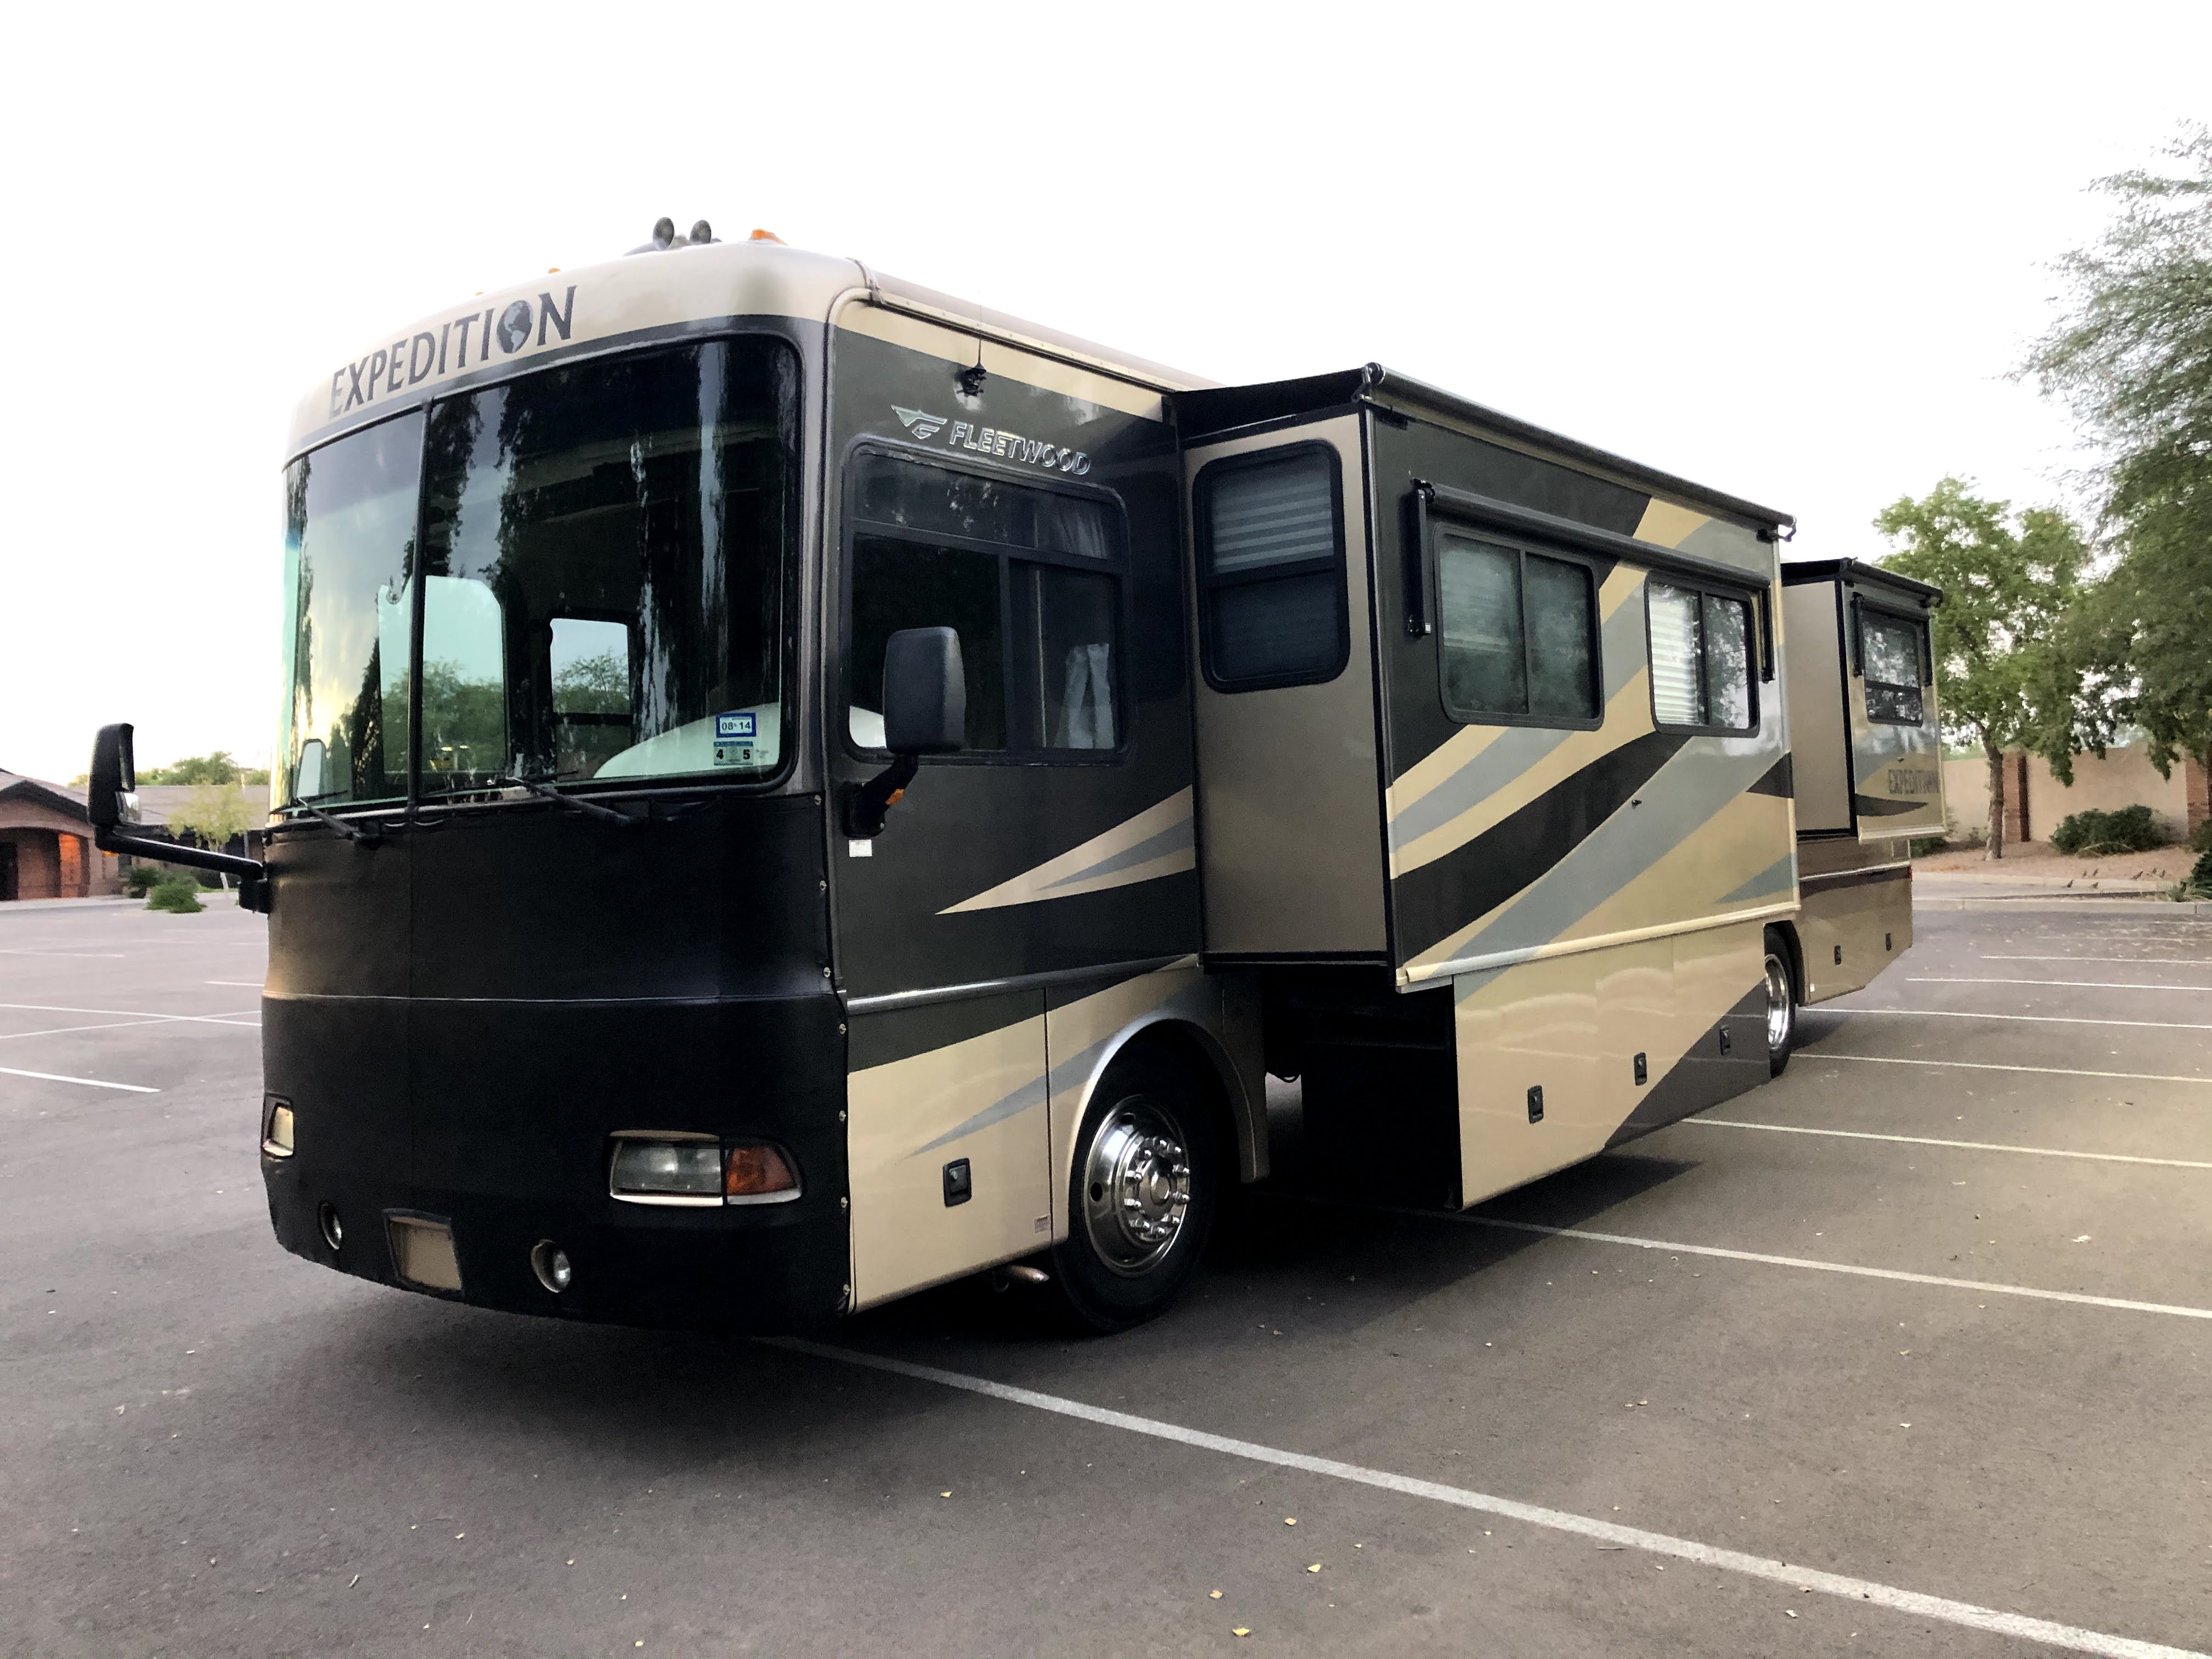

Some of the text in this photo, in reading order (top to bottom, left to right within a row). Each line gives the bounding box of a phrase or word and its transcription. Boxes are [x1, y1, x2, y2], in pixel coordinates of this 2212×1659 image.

[330, 285, 578, 418] EXPEDITION
[949, 420, 1092, 476] FLEETWOOD
[716, 749, 724, 760] 4
[743, 749, 751, 760] 5
